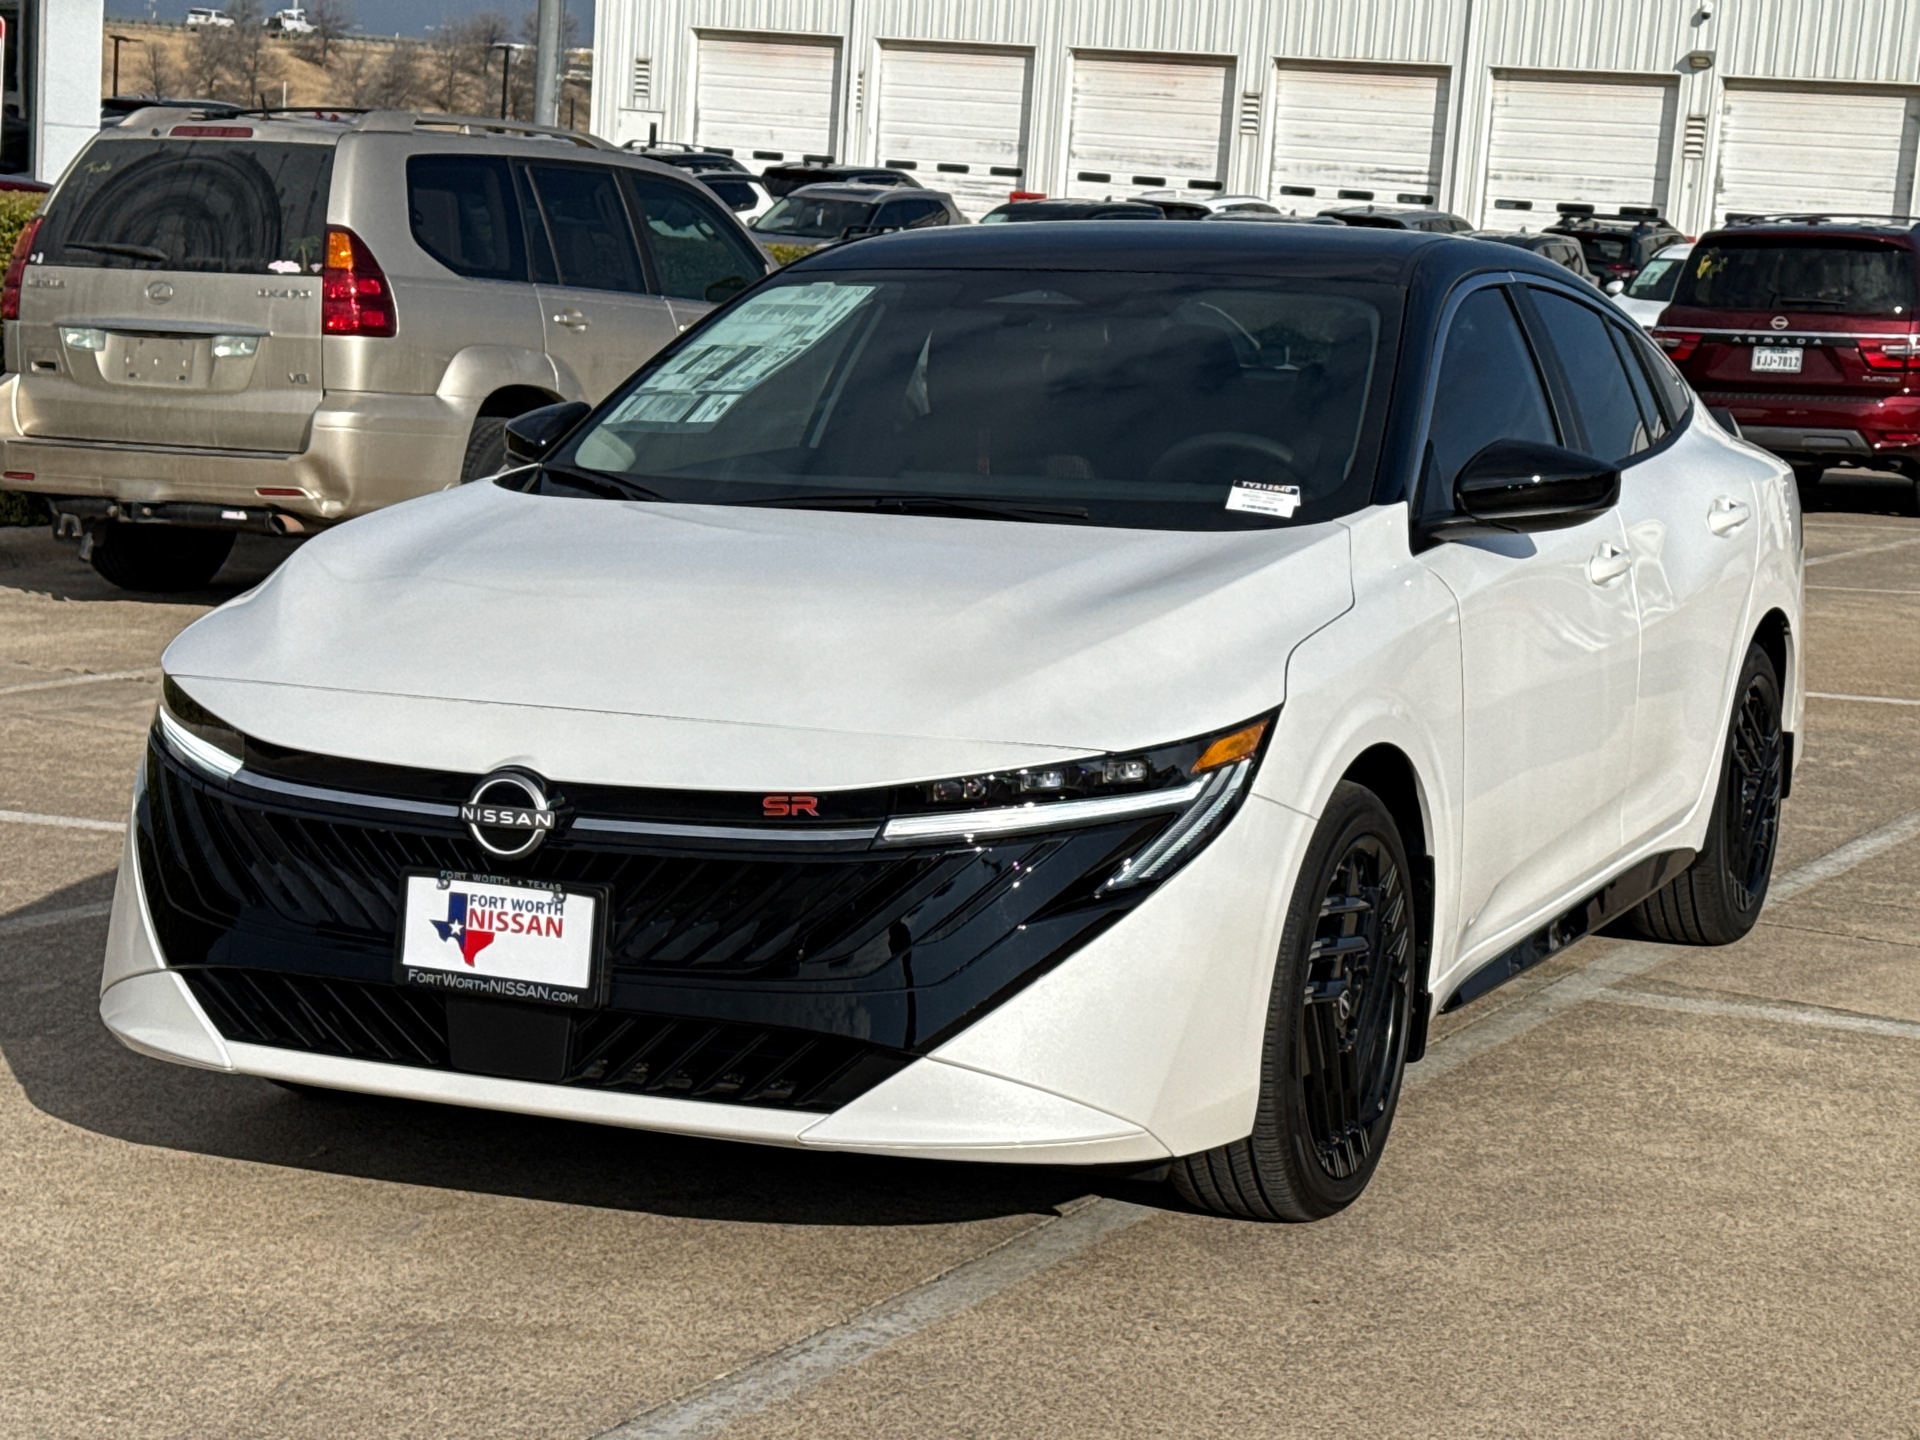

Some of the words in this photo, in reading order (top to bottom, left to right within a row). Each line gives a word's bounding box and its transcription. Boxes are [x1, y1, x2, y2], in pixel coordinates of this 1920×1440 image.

[1732, 336, 1822, 345] ARMADA
[462, 806, 551, 827] NISSAN
[763, 796, 820, 816] SR
[440, 870, 467, 881] FORT
[473, 873, 511, 886] WORTH
[527, 879, 563, 892] TEXAS
[469, 894, 508, 910] FORT
[511, 898, 564, 916] WORTH
[468, 907, 564, 938] NISSAN
